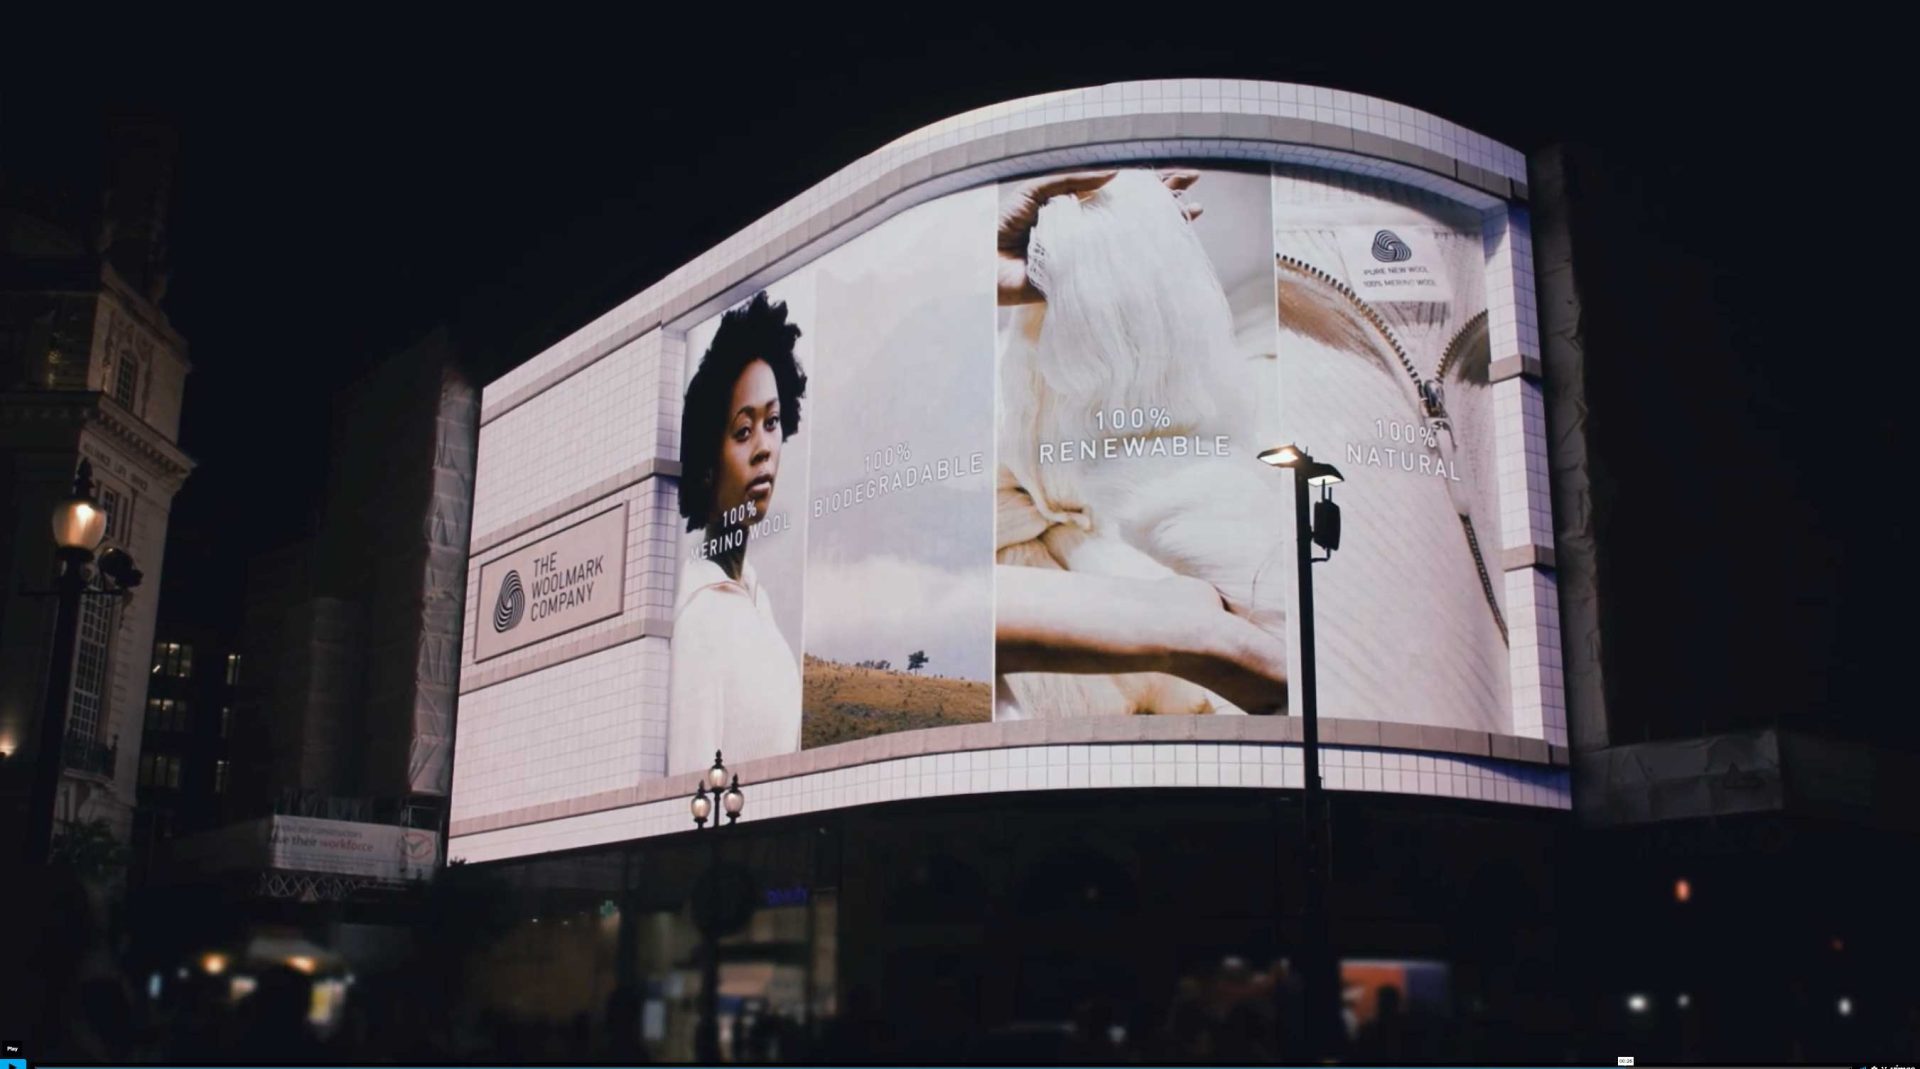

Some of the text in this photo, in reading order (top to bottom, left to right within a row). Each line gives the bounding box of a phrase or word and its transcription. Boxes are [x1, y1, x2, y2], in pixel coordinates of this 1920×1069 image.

[1095, 407, 1170, 430] 100%
[1375, 419, 1436, 448] 100%
[864, 442, 911, 472] 100%
[1039, 435, 1230, 464] RENEWABLE
[1346, 443, 1461, 481] NATURAL
[814, 453, 983, 518] BIODEGRADABLE
[723, 500, 757, 527] 100%
[690, 513, 791, 561] MERINO WOOL
[531, 555, 604, 599] WOOLMARK
[533, 552, 557, 577] THE
[530, 582, 595, 622] COMPANY
[320, 838, 374, 852] workforce
